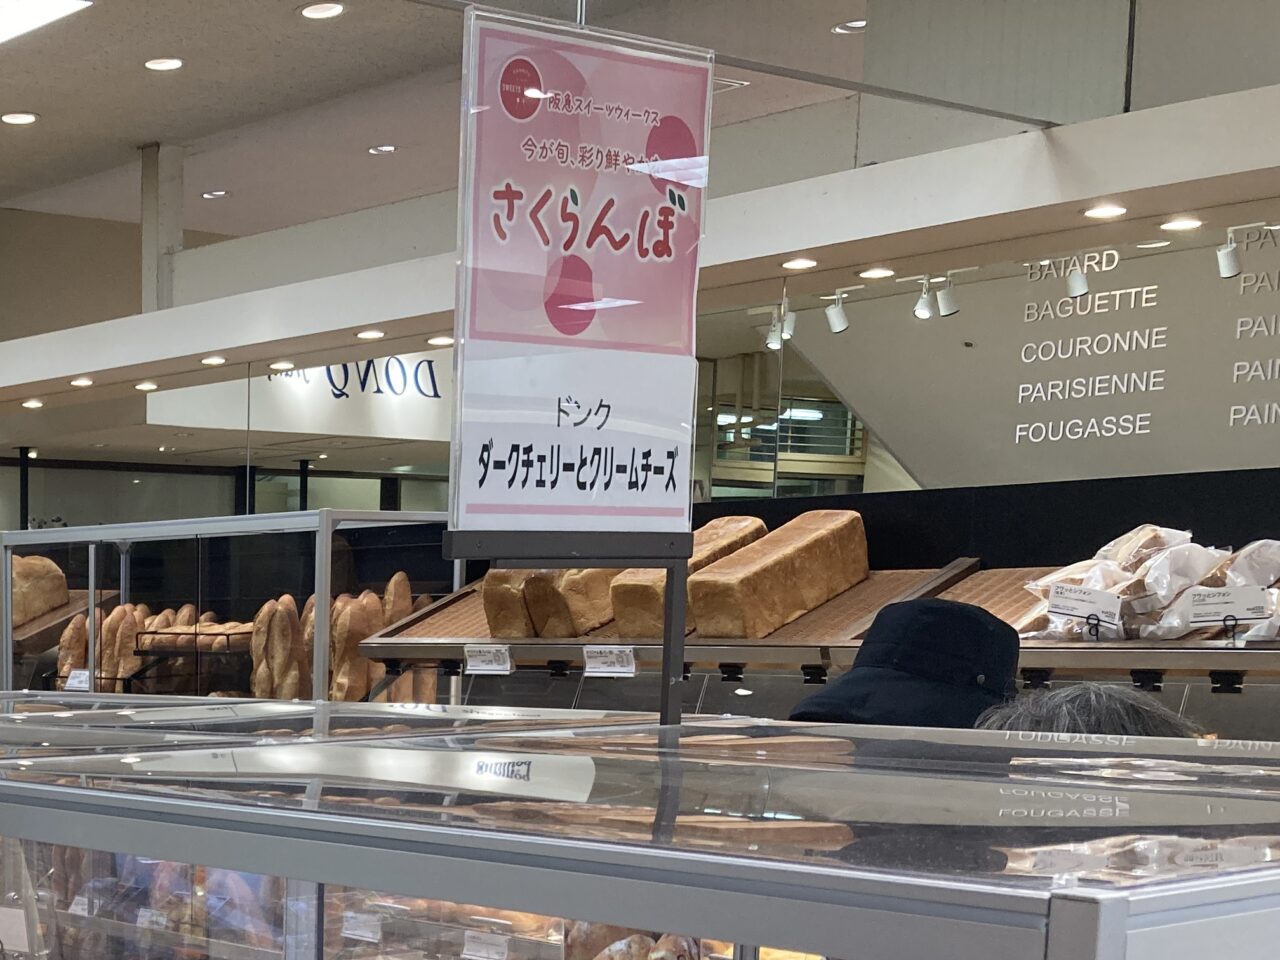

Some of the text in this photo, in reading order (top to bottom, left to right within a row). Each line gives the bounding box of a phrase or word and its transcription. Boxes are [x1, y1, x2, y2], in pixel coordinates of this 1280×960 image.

[548, 93, 660, 125] 阪急スイーツウィークス
[522, 138, 658, 175] 今が旬、彩り鮮や
[492, 183, 687, 259] さくらんぼ
[1027, 250, 1119, 282] BATARD
[1023, 285, 1158, 323] BAGUETTE
[1020, 327, 1168, 363] COURONNE
[1018, 370, 1166, 403] PARISIENNE
[556, 397, 611, 431] ドンク
[1015, 413, 1151, 444] FOUGASSE
[477, 438, 679, 492] ダークチェリーとクリームチーズ
